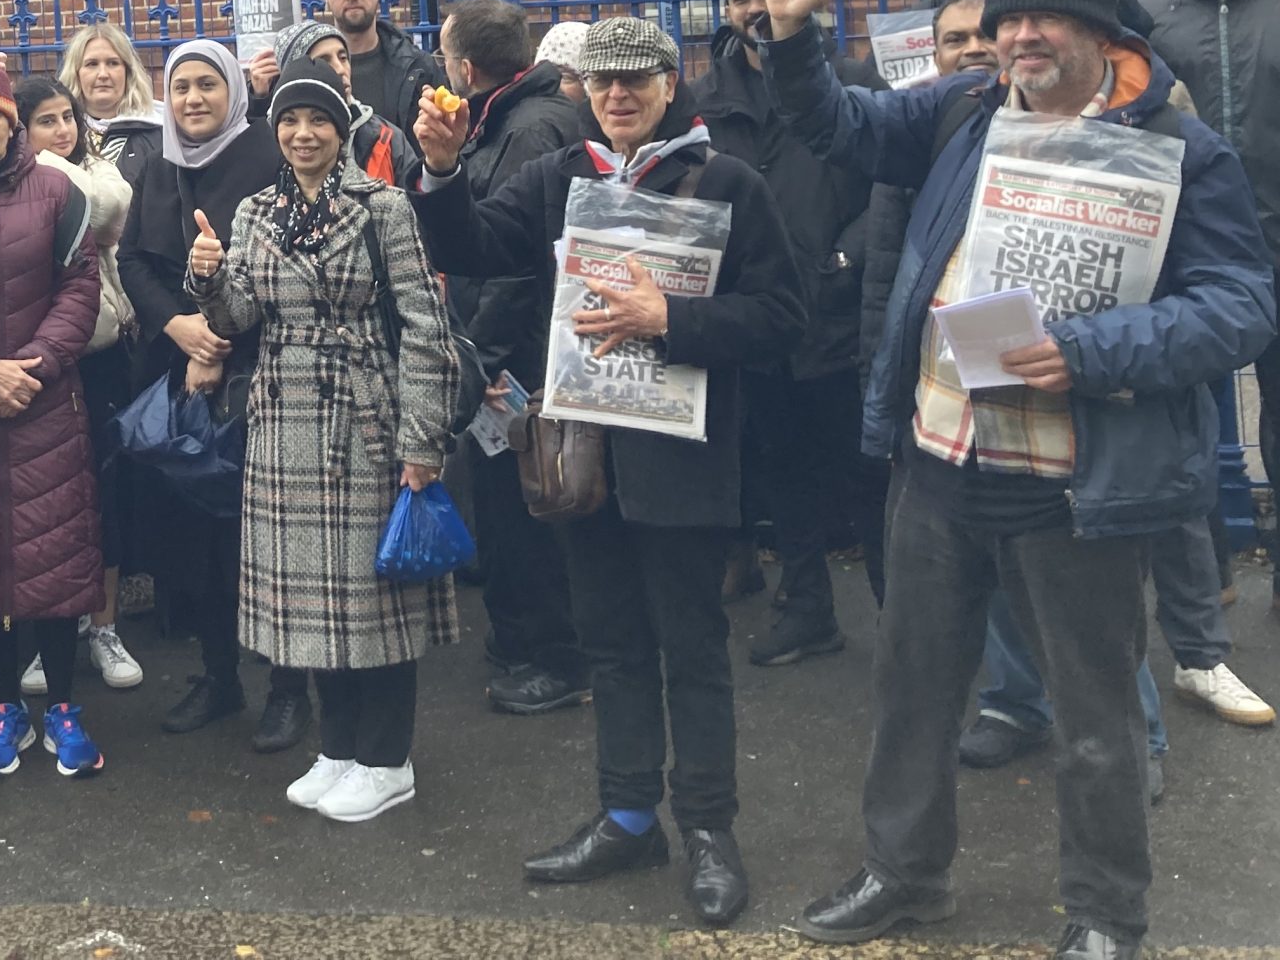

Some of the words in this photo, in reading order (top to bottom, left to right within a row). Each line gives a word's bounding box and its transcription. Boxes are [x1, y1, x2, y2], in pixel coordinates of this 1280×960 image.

[241, 14, 273, 32] GAZA!
[884, 56, 925, 80] STOP
[999, 188, 1085, 219] Socialist
[1088, 200, 1158, 233] Worker
[985, 210, 1010, 220] BACK
[1032, 218, 1093, 237] PALESTINIAN
[1094, 230, 1150, 249] RESISTANCE
[1002, 224, 1125, 269] SMASH
[651, 269, 707, 292] Worker
[995, 247, 1122, 293] ISRAELI
[584, 355, 666, 384] STATE
